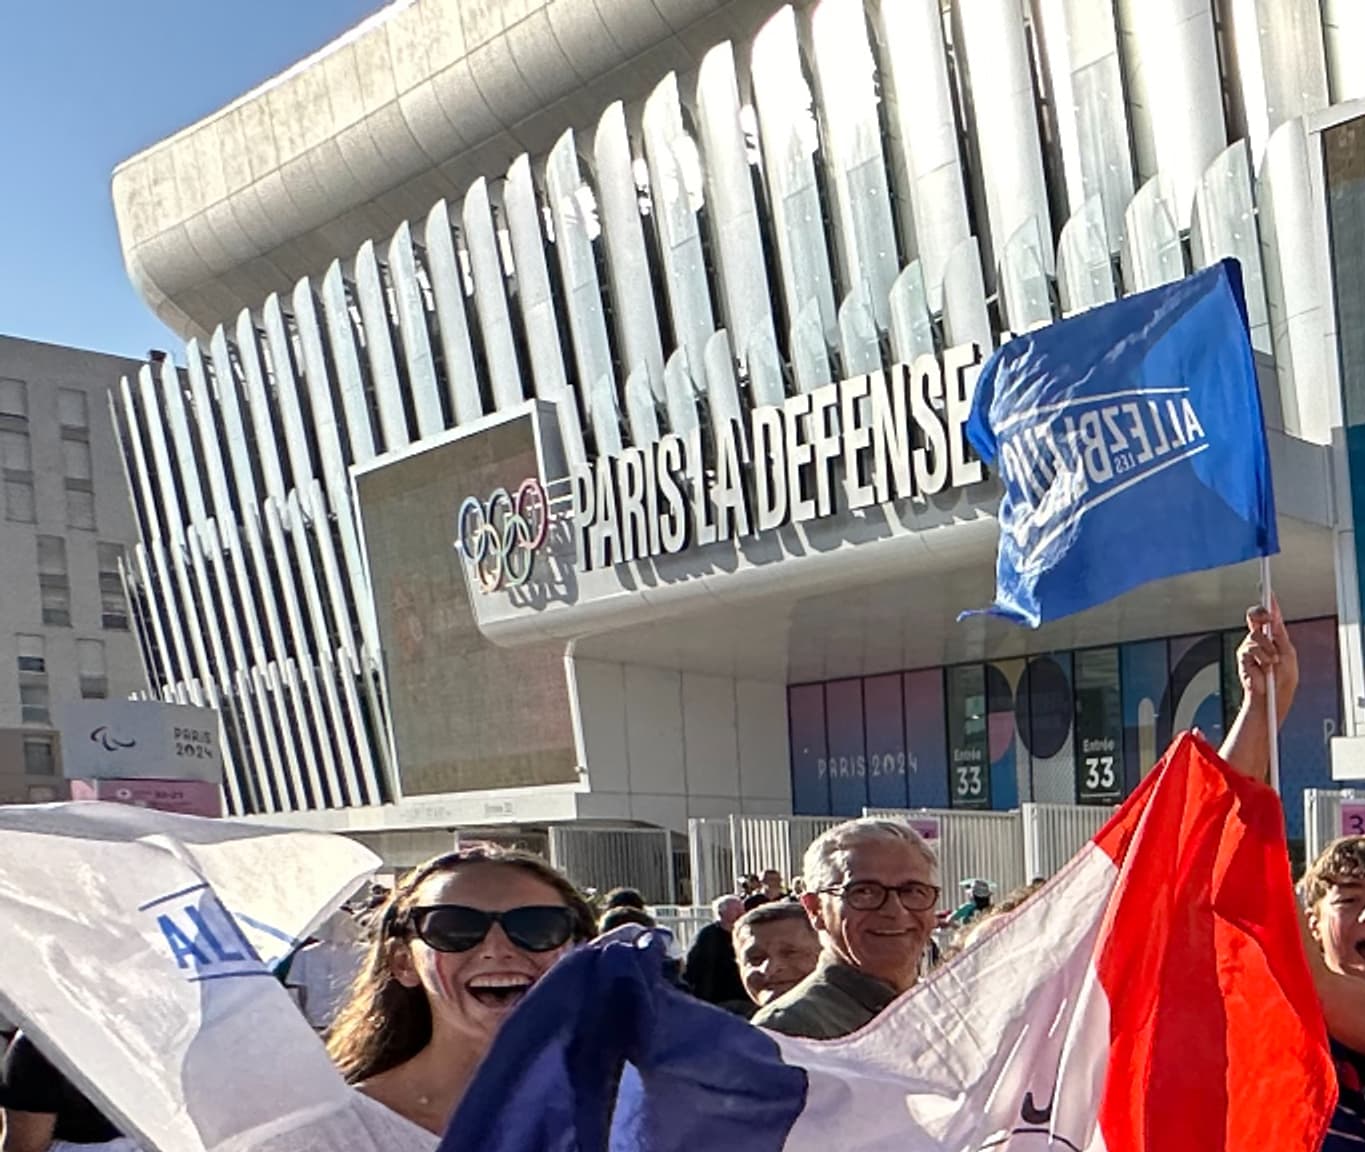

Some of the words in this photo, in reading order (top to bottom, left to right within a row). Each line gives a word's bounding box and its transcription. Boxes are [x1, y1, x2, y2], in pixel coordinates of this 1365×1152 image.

[572, 434, 686, 573] PARIS
[687, 413, 750, 546] LA
[752, 342, 983, 541] DEFENSE
[173, 727, 212, 744] PARIS
[175, 743, 213, 759] 2024
[817, 755, 866, 779] PARIS
[871, 751, 918, 777] 2024
[956, 766, 982, 795] 33
[1085, 756, 1116, 789] 33
